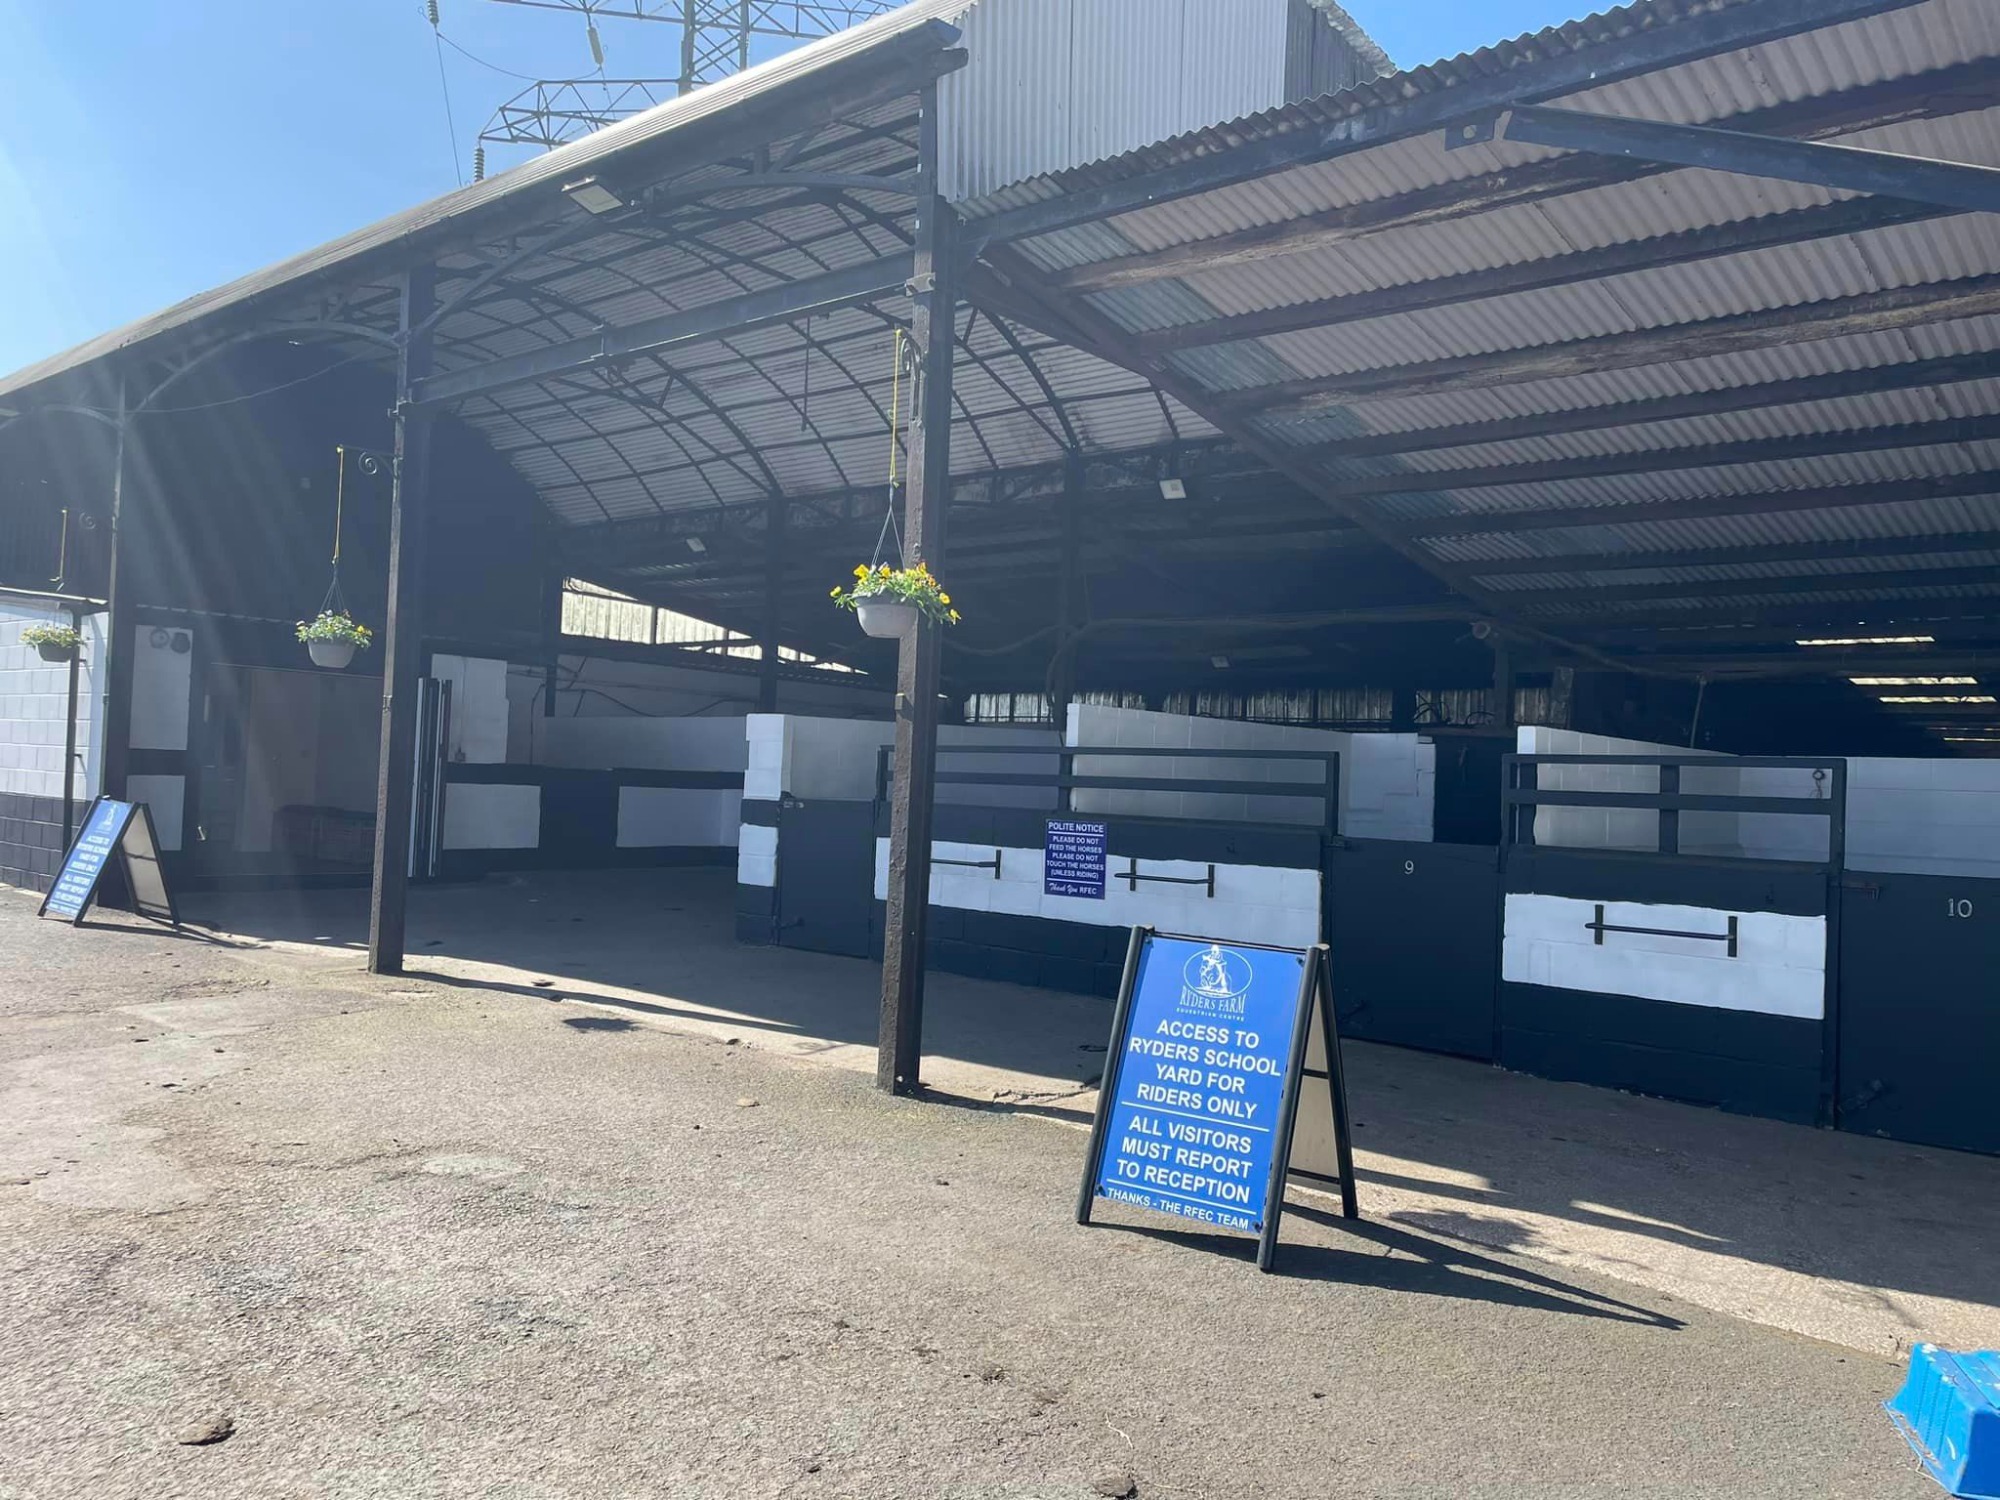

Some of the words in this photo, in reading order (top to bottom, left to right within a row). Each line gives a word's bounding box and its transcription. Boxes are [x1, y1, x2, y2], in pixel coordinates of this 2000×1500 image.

[1048, 822, 1074, 831] POLITE
[1076, 824, 1104, 832] NOTICE
[1404, 860, 1414, 875] 9
[1948, 898, 1973, 918] 10
[1180, 986, 1215, 1010] RYDERS
[1219, 994, 1246, 1013] FARM
[1157, 1019, 1230, 1045] ACCESS
[1234, 1031, 1259, 1047] TO
[1129, 1037, 1199, 1062] RYDERS
[1203, 1051, 1281, 1076] SCHOOL
[1156, 1064, 1202, 1086] YARD
[1207, 1074, 1245, 1094] FOR
[1137, 1083, 1201, 1110] RIDERS
[1207, 1097, 1257, 1119] ONLY
[1129, 1115, 1162, 1137] ALL
[1168, 1124, 1252, 1154] VISITORS
[1122, 1137, 1171, 1161] MUST
[1176, 1151, 1252, 1179] REPORT
[1116, 1159, 1140, 1178] TO
[1144, 1165, 1250, 1203] RECEPTION
[1108, 1187, 1151, 1207] THANKS
[1160, 1200, 1181, 1212] THE
[1184, 1206, 1213, 1221] RFEC
[1217, 1213, 1248, 1230] TEAM
